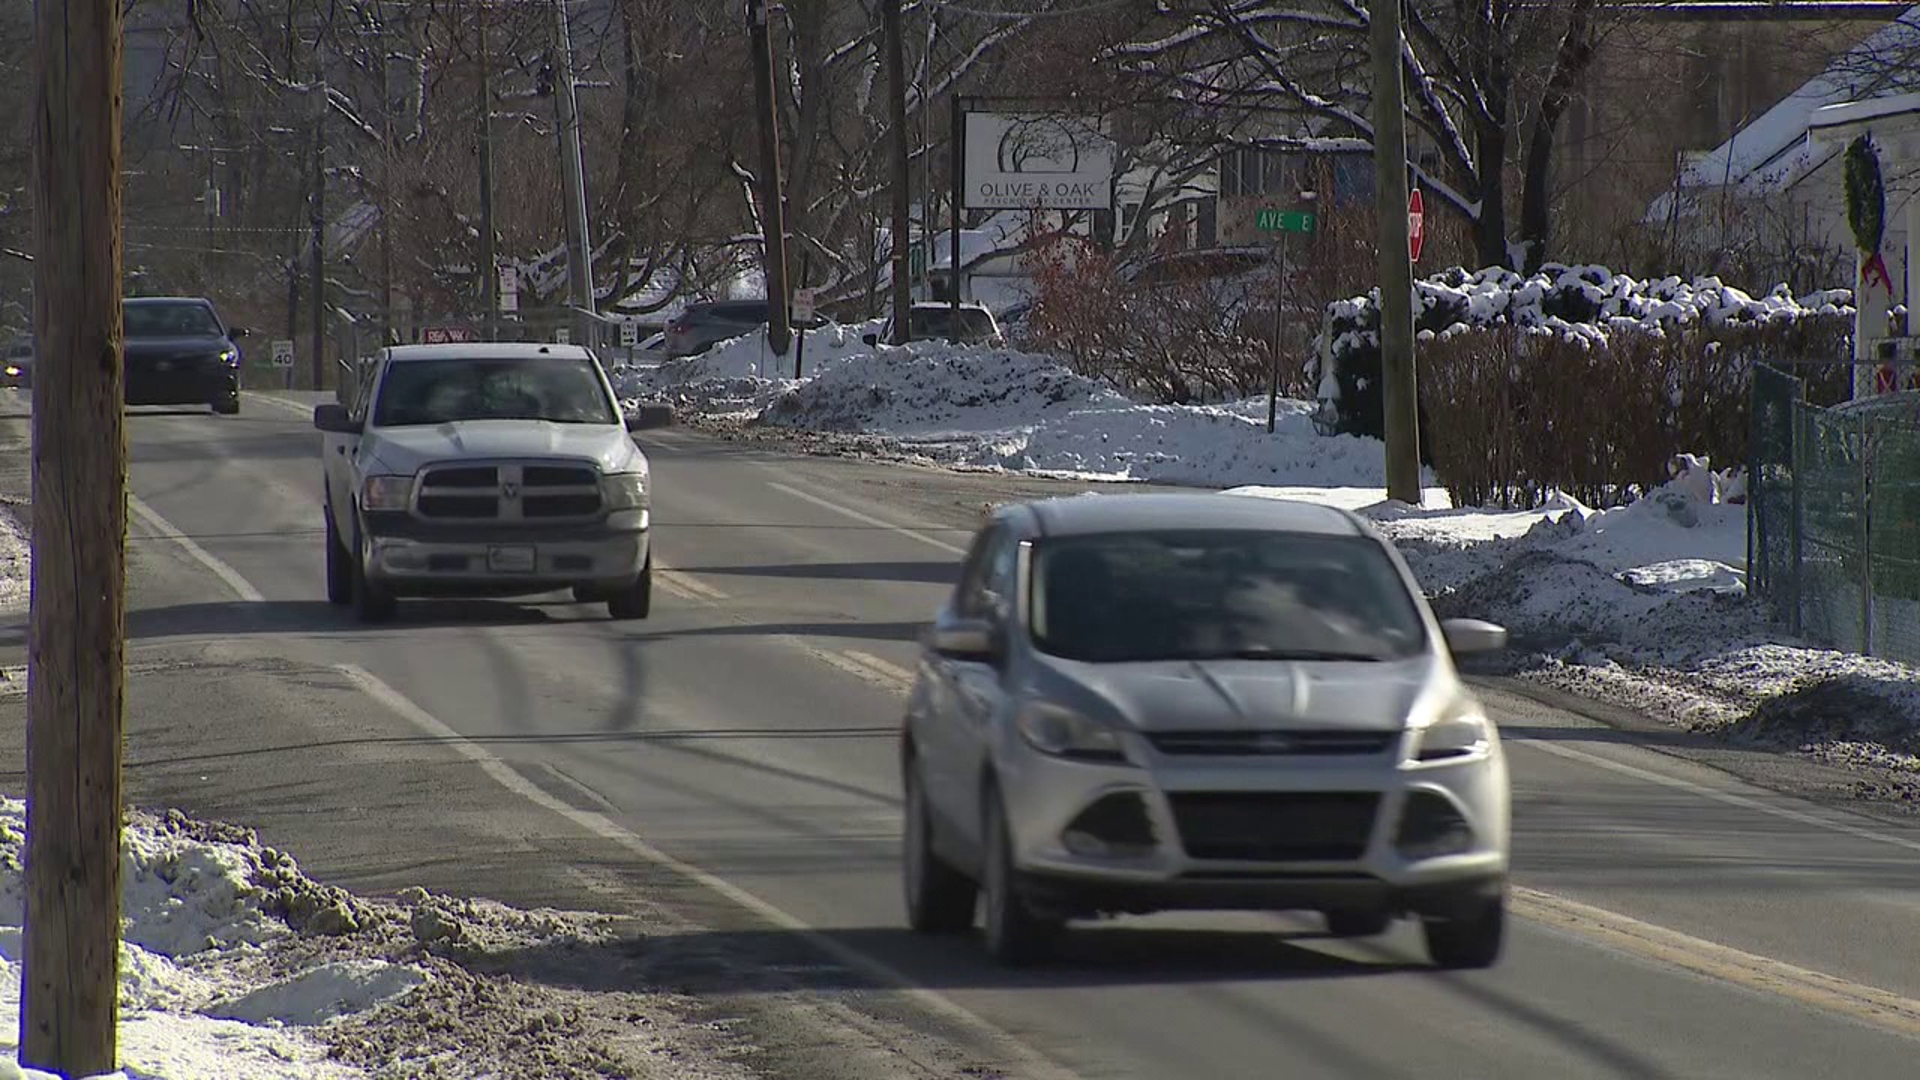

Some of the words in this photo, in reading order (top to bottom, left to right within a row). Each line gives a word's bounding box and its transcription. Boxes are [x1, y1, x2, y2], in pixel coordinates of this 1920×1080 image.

[980, 182, 1033, 197] OLIVE
[1039, 182, 1050, 197] &
[1055, 182, 1095, 197] OAK
[1053, 197, 1091, 205] CENTER
[1259, 211, 1284, 229] AVE
[1301, 214, 1309, 231] E
[274, 353, 292, 364] 40
